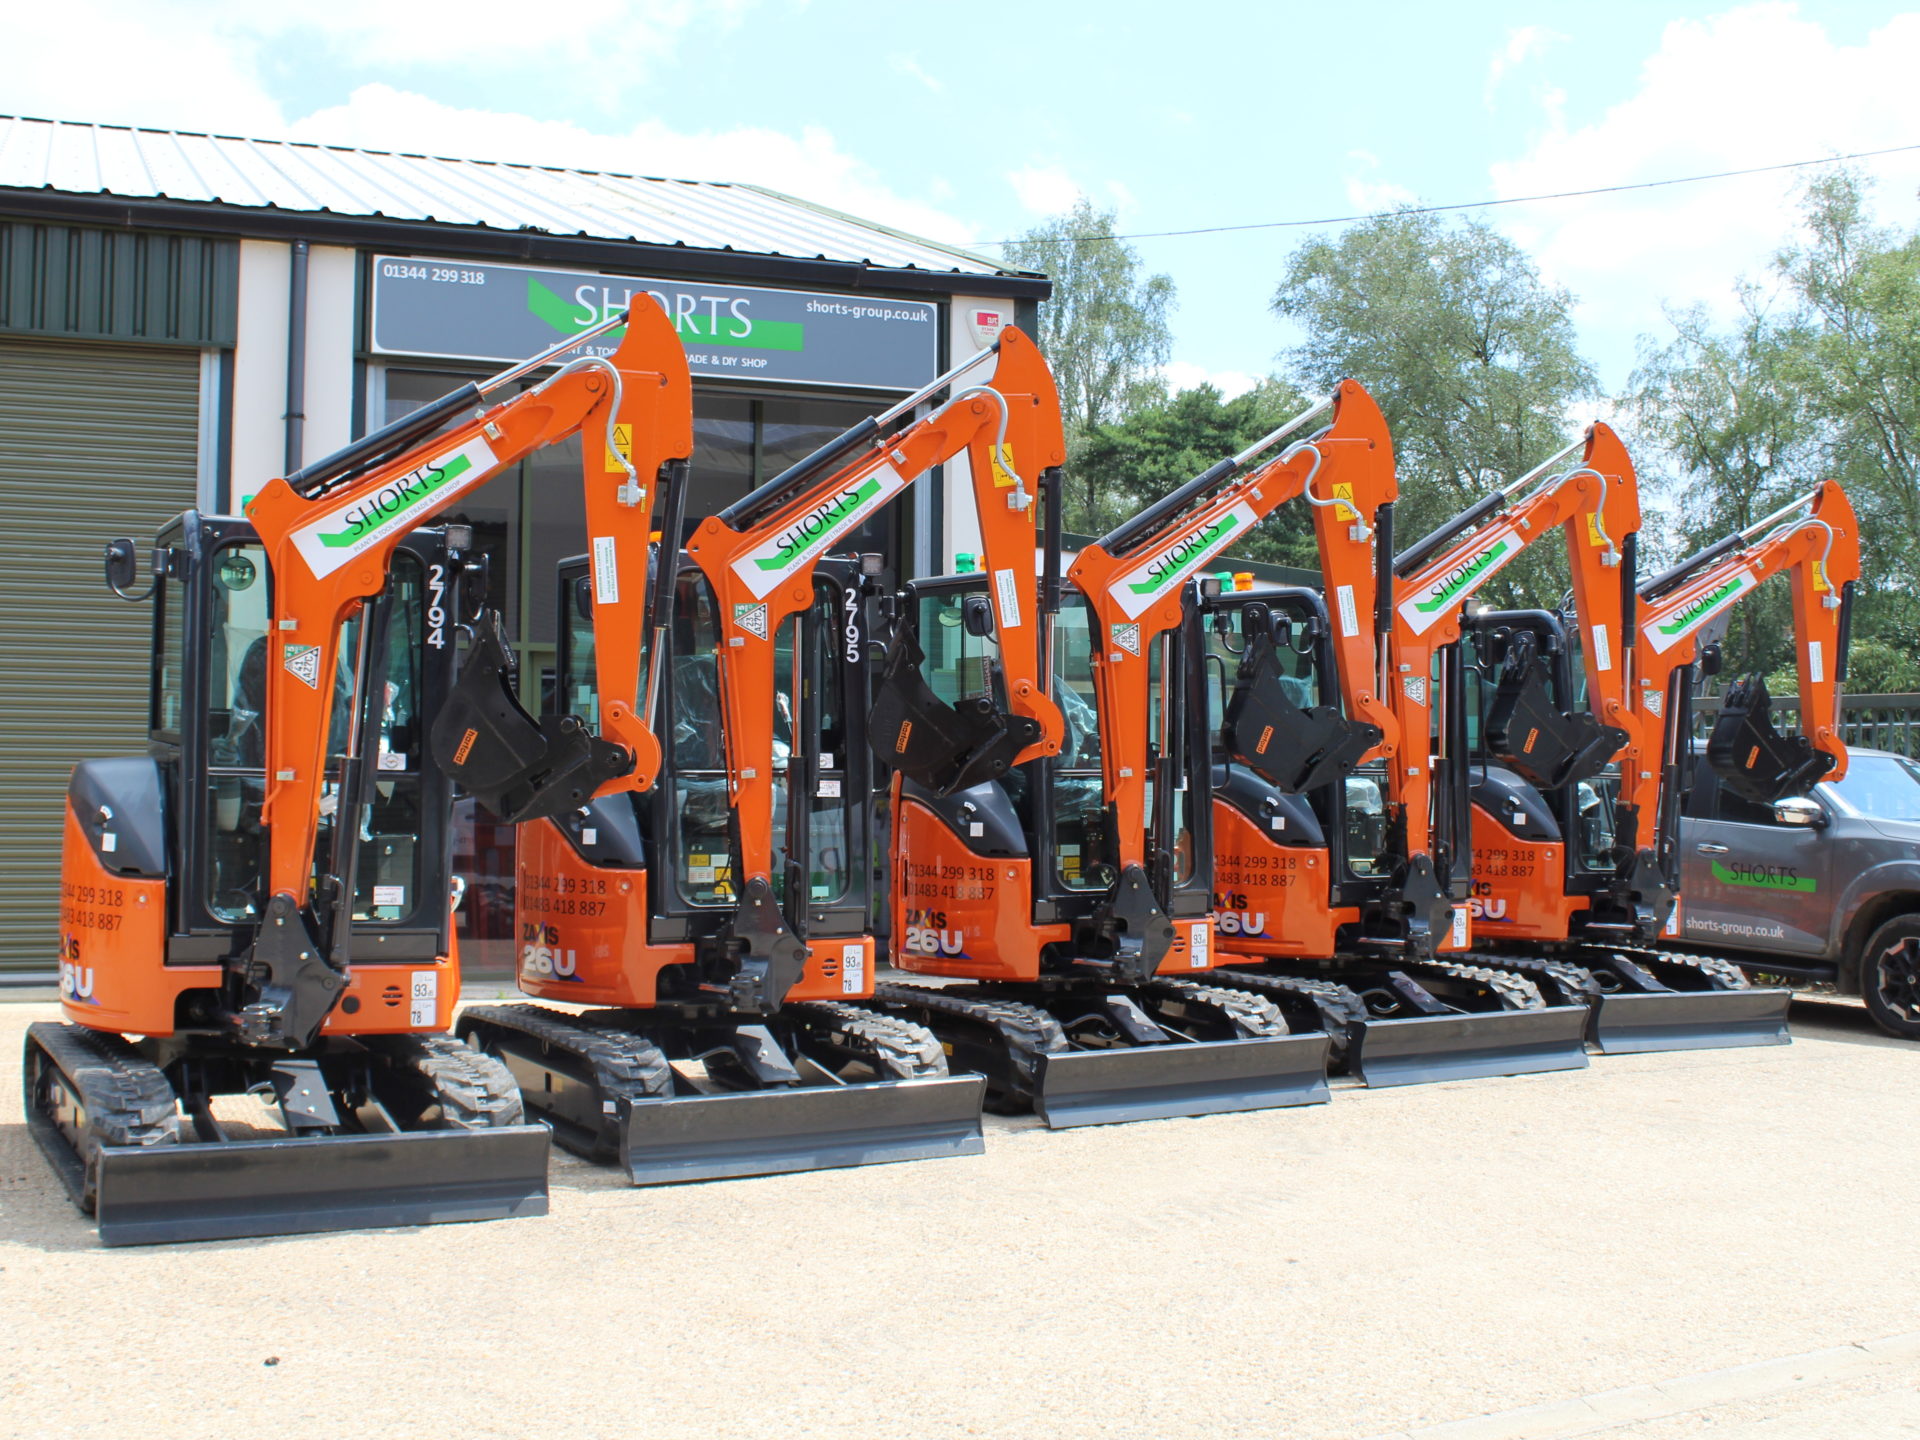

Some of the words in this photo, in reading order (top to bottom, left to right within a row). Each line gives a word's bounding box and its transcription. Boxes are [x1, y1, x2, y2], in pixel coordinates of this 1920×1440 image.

[383, 264, 427, 280] 01344
[431, 268, 458, 283] 299
[460, 271, 485, 285] 318
[806, 300, 928, 322] shorts-group.co.uk
[711, 355, 720, 365] &
[722, 356, 738, 367] DIY
[741, 357, 768, 368] SHOP
[345, 460, 446, 536] SHORTS
[776, 489, 860, 559] SHORTS
[1147, 523, 1220, 584] SHORTS
[1430, 550, 1492, 604] SHORTS
[427, 564, 446, 650] 2794
[1672, 585, 1729, 628] SHORTS
[845, 587, 860, 663] 2795
[1215, 855, 1240, 867] 1344
[1244, 856, 1267, 869] 299
[1271, 857, 1296, 870] 318
[1486, 849, 1508, 861] 299
[1512, 850, 1535, 861] 318
[909, 864, 937, 879] 01344
[941, 866, 964, 880] 299
[968, 867, 994, 881] 318
[1215, 871, 1240, 885] 1483
[1243, 873, 1267, 886] 418
[1271, 874, 1296, 887] 887
[1485, 864, 1508, 876] 418
[1512, 865, 1535, 877] 887
[1730, 862, 1798, 887] SHORTS
[77, 886, 95, 904] 299
[98, 888, 123, 907] 318
[580, 879, 606, 895] 318
[909, 883, 938, 897] 01483
[941, 885, 964, 899] 418
[968, 887, 994, 900] 887
[553, 899, 575, 915] 418
[579, 901, 606, 917] 887
[1214, 890, 1248, 910] AXIS
[77, 911, 95, 928] 418
[98, 913, 123, 931] 887
[906, 907, 947, 929] ZAXIS
[1686, 916, 1785, 938] shorts-group.co.uk
[523, 922, 559, 945] ZAXIS
[906, 927, 963, 954] 26U
[524, 945, 576, 976] 26U
[845, 956, 856, 968] 93
[414, 983, 427, 997] 93
[844, 979, 853, 991] 78
[412, 1010, 422, 1024] 78
